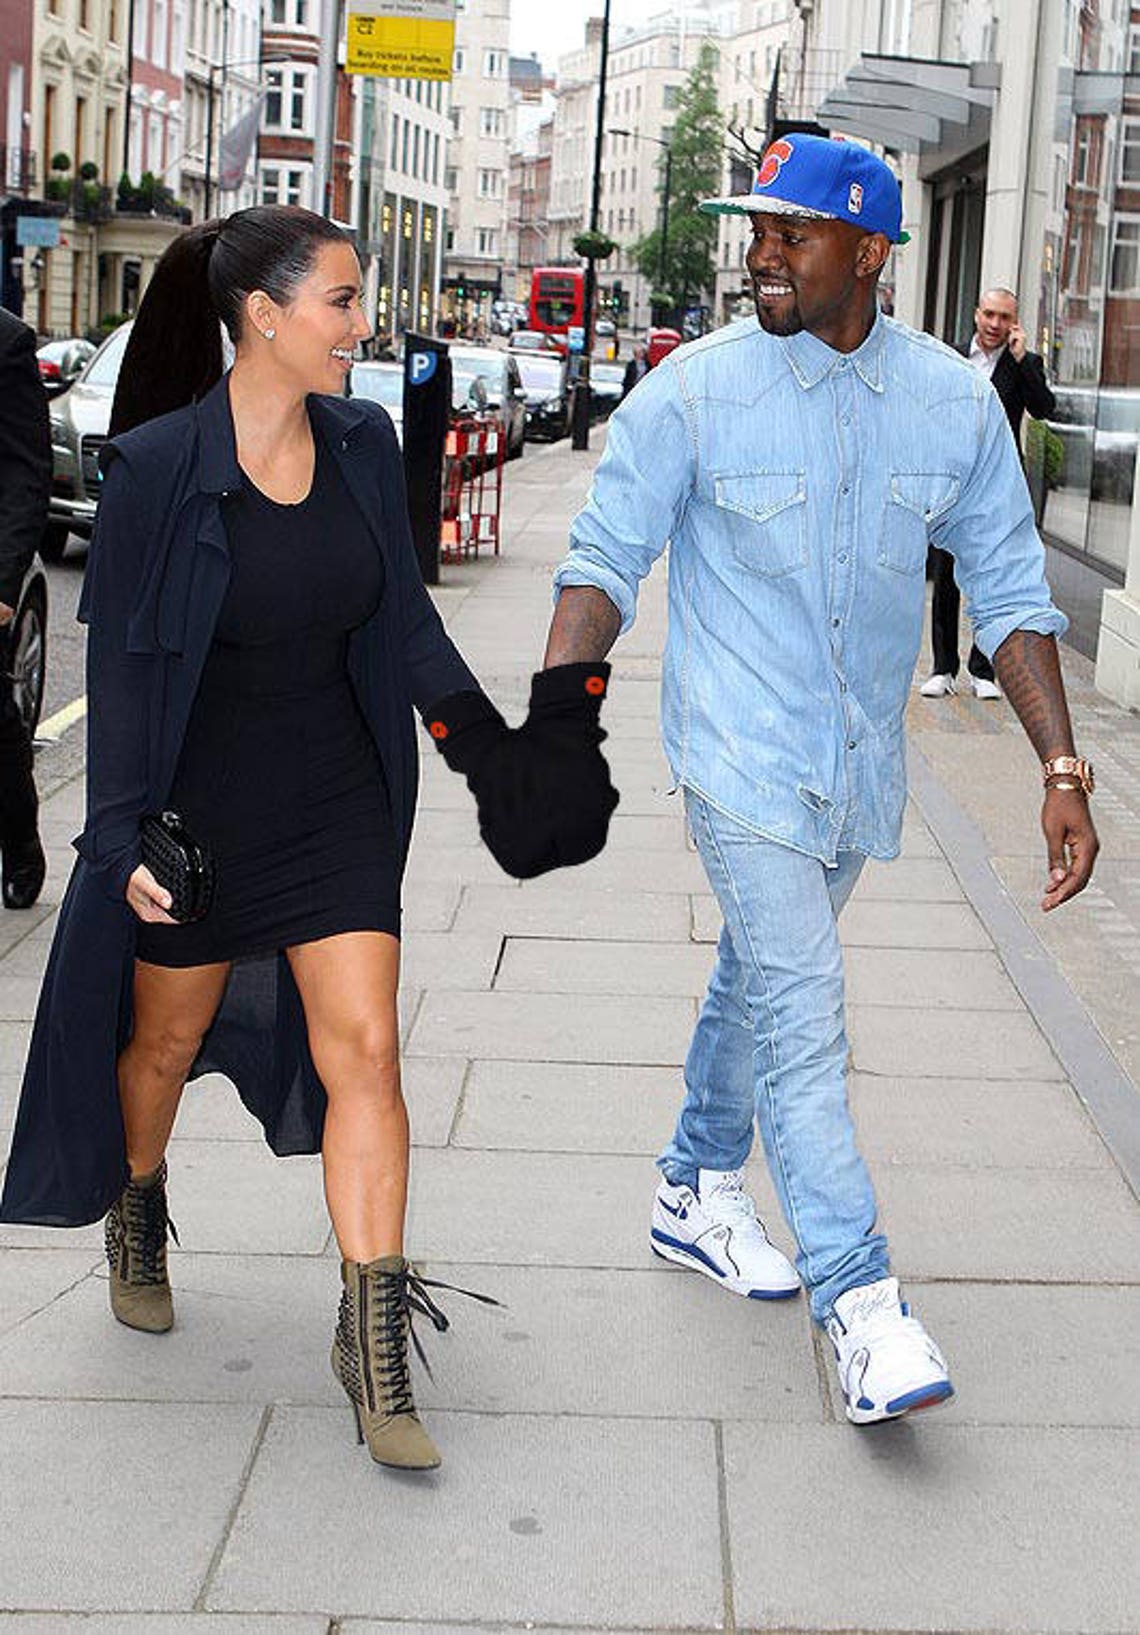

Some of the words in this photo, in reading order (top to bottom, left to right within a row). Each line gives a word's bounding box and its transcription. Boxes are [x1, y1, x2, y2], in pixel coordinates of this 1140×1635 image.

[357, 50, 373, 59] Buy
[376, 51, 407, 61] tickets
[411, 54, 441, 63] before
[348, 60, 388, 72] boarding
[390, 63, 403, 71] on
[405, 64, 416, 73] all
[418, 67, 448, 75] routes
[412, 352, 430, 378] P
